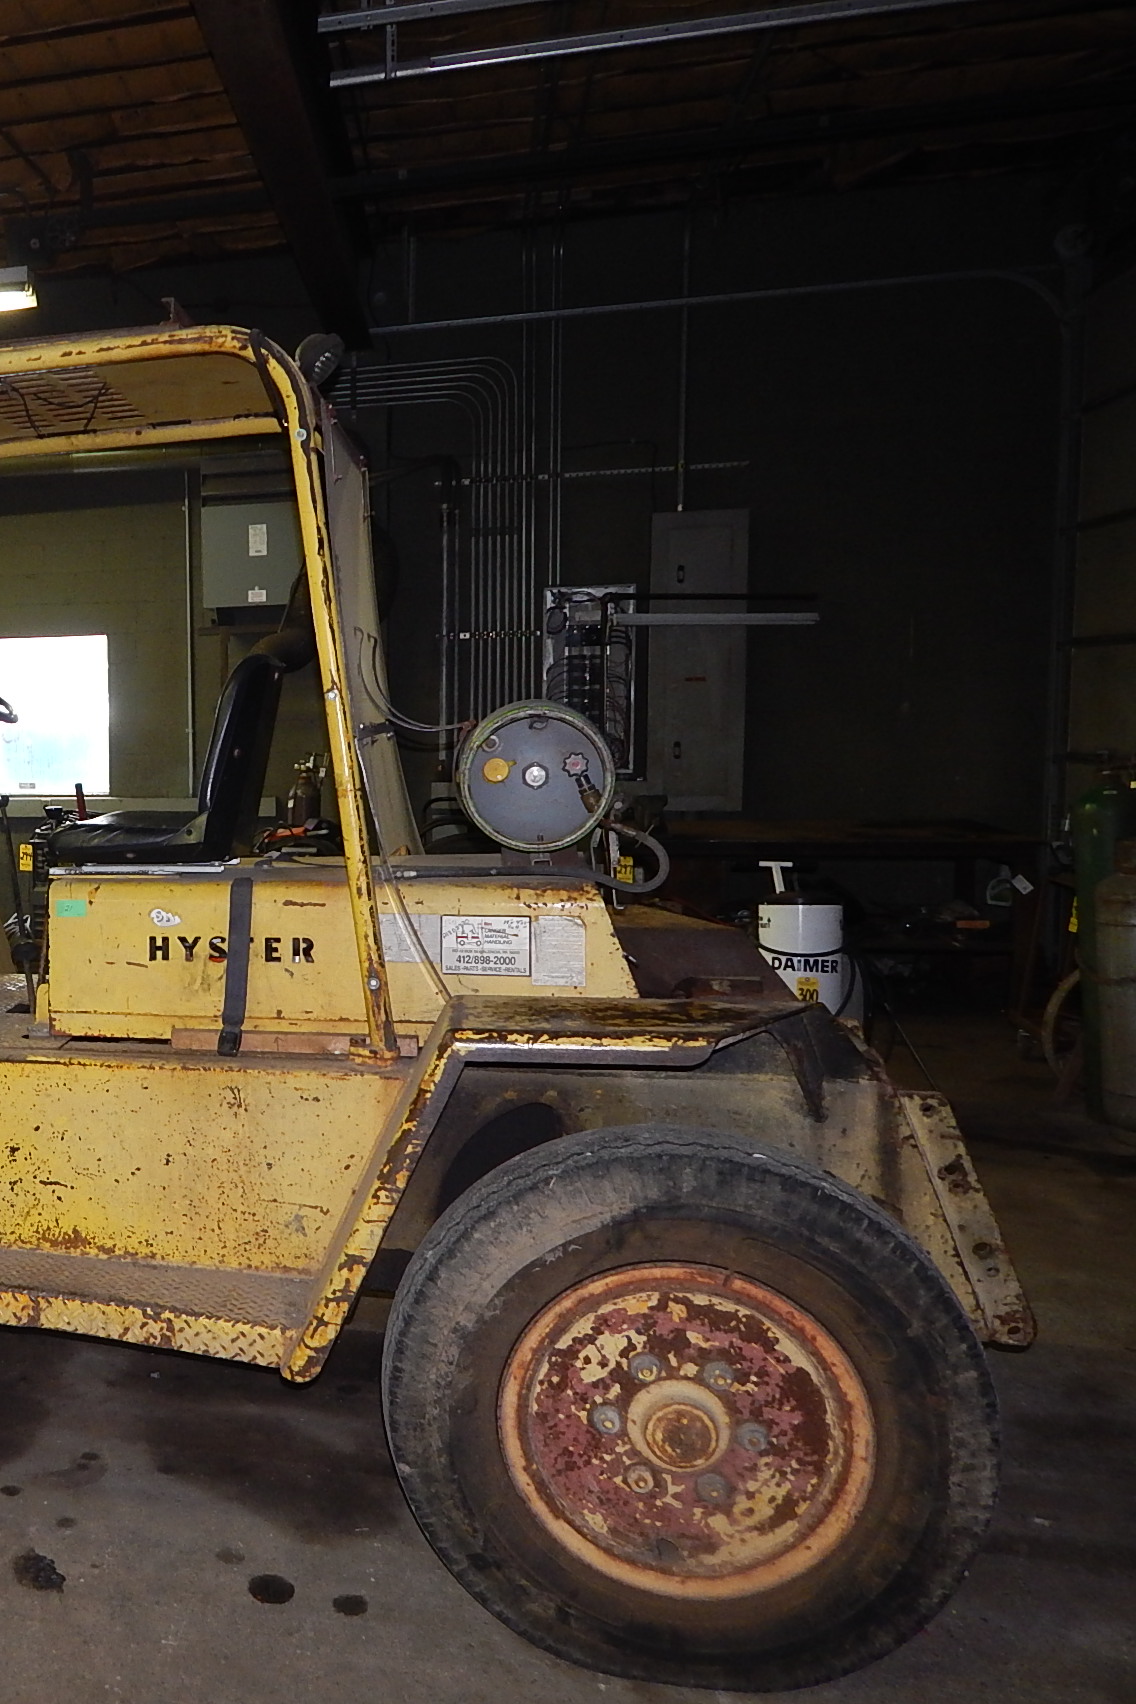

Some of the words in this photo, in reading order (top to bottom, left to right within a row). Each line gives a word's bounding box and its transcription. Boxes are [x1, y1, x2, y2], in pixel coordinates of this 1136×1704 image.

[148, 935, 315, 964] HYSER
[455, 954, 516, 965] 412/898-2000
[771, 956, 839, 974] DAIMER
